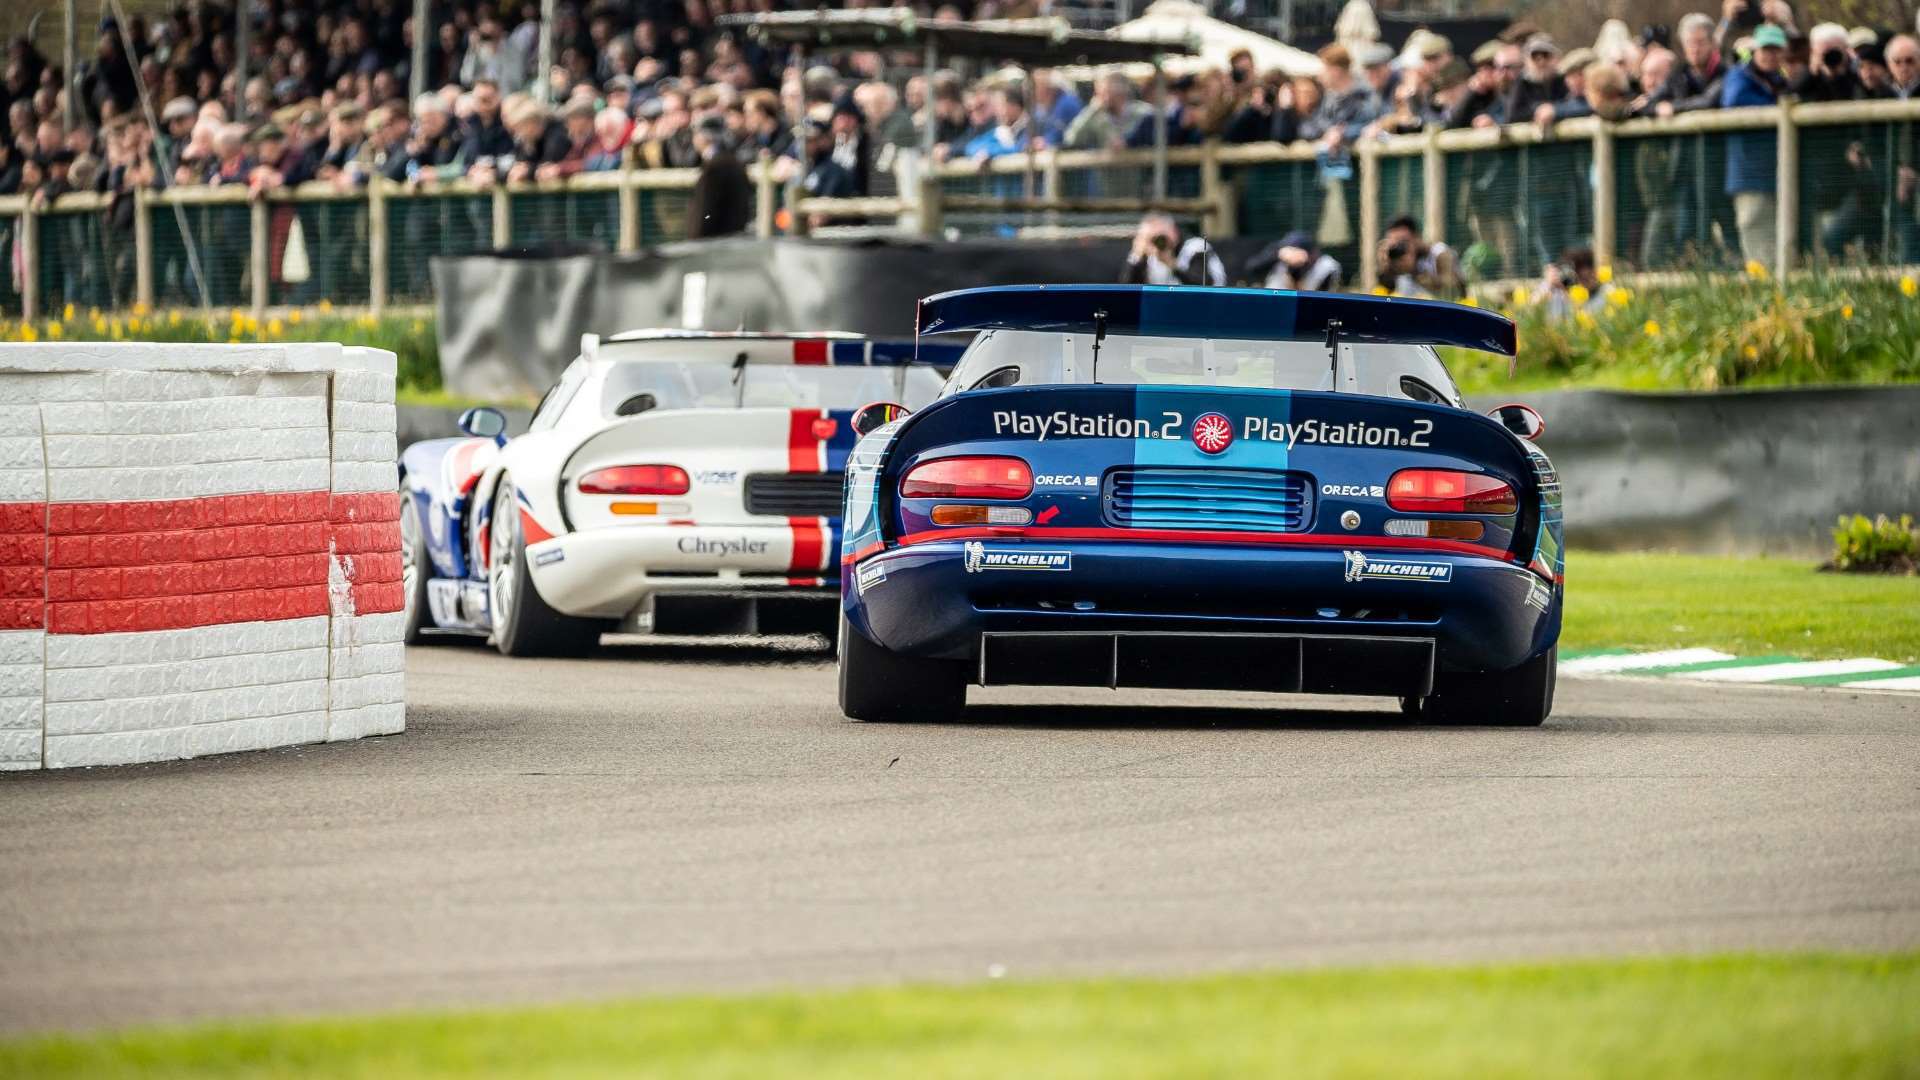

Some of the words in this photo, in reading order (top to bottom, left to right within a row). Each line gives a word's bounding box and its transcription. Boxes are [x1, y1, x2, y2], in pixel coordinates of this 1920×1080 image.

[1035, 475, 1082, 486] ORECA
[1321, 484, 1369, 497] ORECA
[677, 536, 768, 557] Chrysler
[985, 554, 1067, 565] MICHELIN
[1367, 563, 1449, 577] MICHELIN
